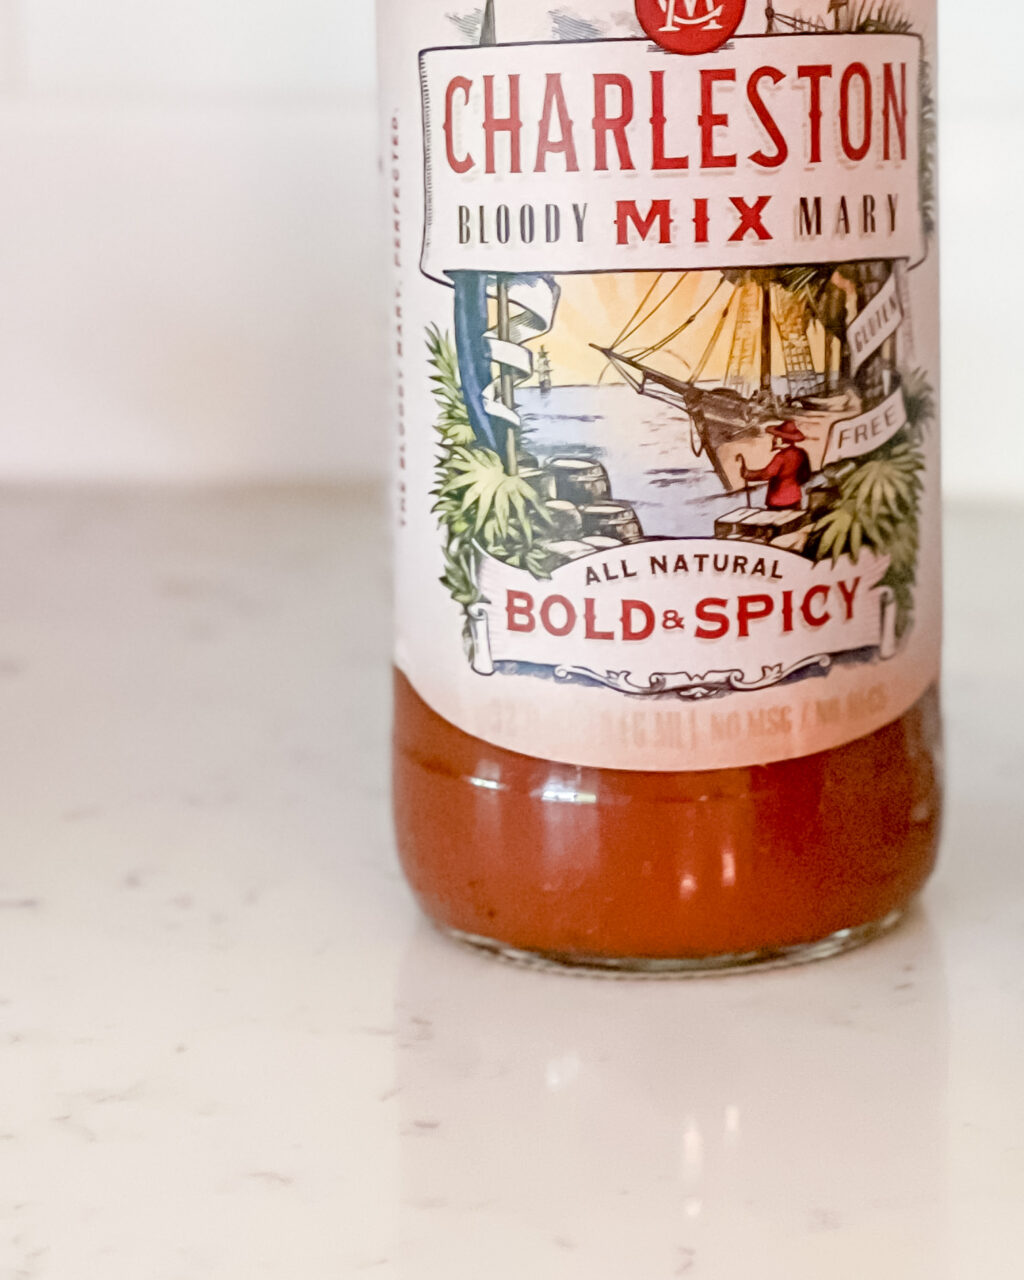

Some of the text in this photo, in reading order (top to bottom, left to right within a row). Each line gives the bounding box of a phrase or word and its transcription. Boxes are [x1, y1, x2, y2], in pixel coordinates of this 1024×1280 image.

[442, 61, 908, 174] CHARLESTON
[457, 193, 900, 245] BLOODY MIX MARY
[853, 294, 898, 353] GLUTEN
[837, 404, 895, 450] FREE
[585, 552, 784, 586] ALL NATURAL
